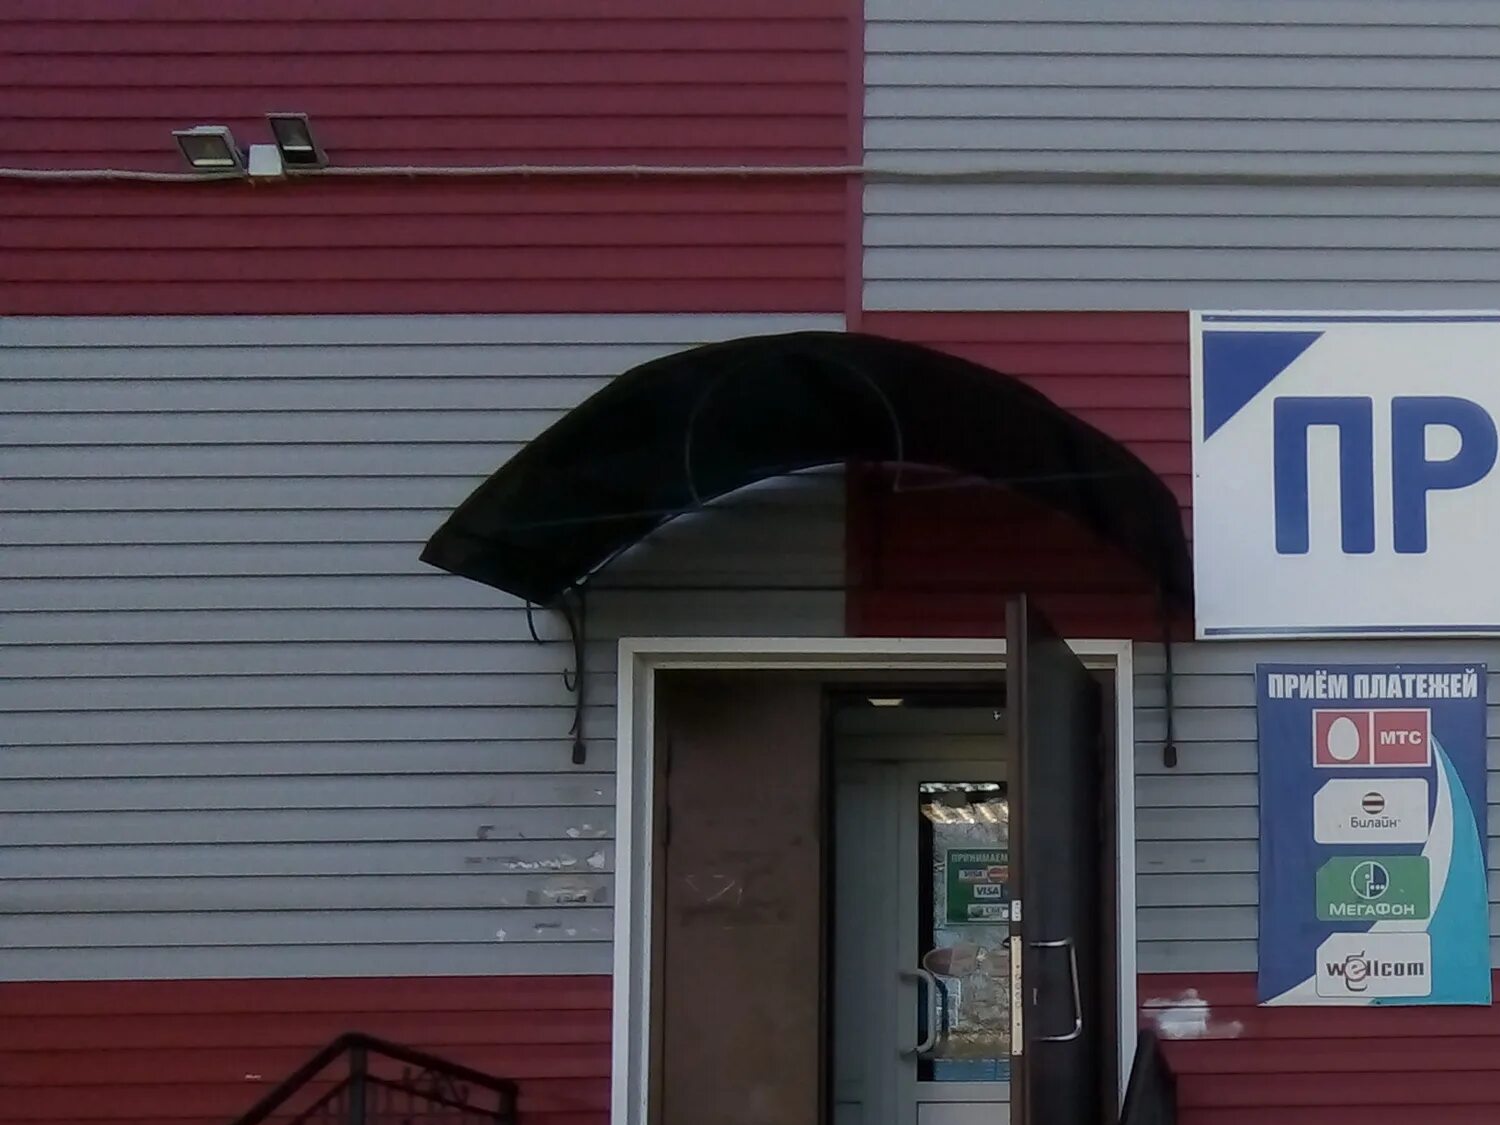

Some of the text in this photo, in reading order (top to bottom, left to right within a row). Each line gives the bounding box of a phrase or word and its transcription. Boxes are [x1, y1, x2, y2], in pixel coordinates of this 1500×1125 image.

[1268, 668, 1478, 699] ПРИЁМ ПЛАТЕЖЕЙ
[1380, 730, 1422, 745] МТС
[1350, 816, 1397, 828] билайн
[976, 886, 999, 895] VISA
